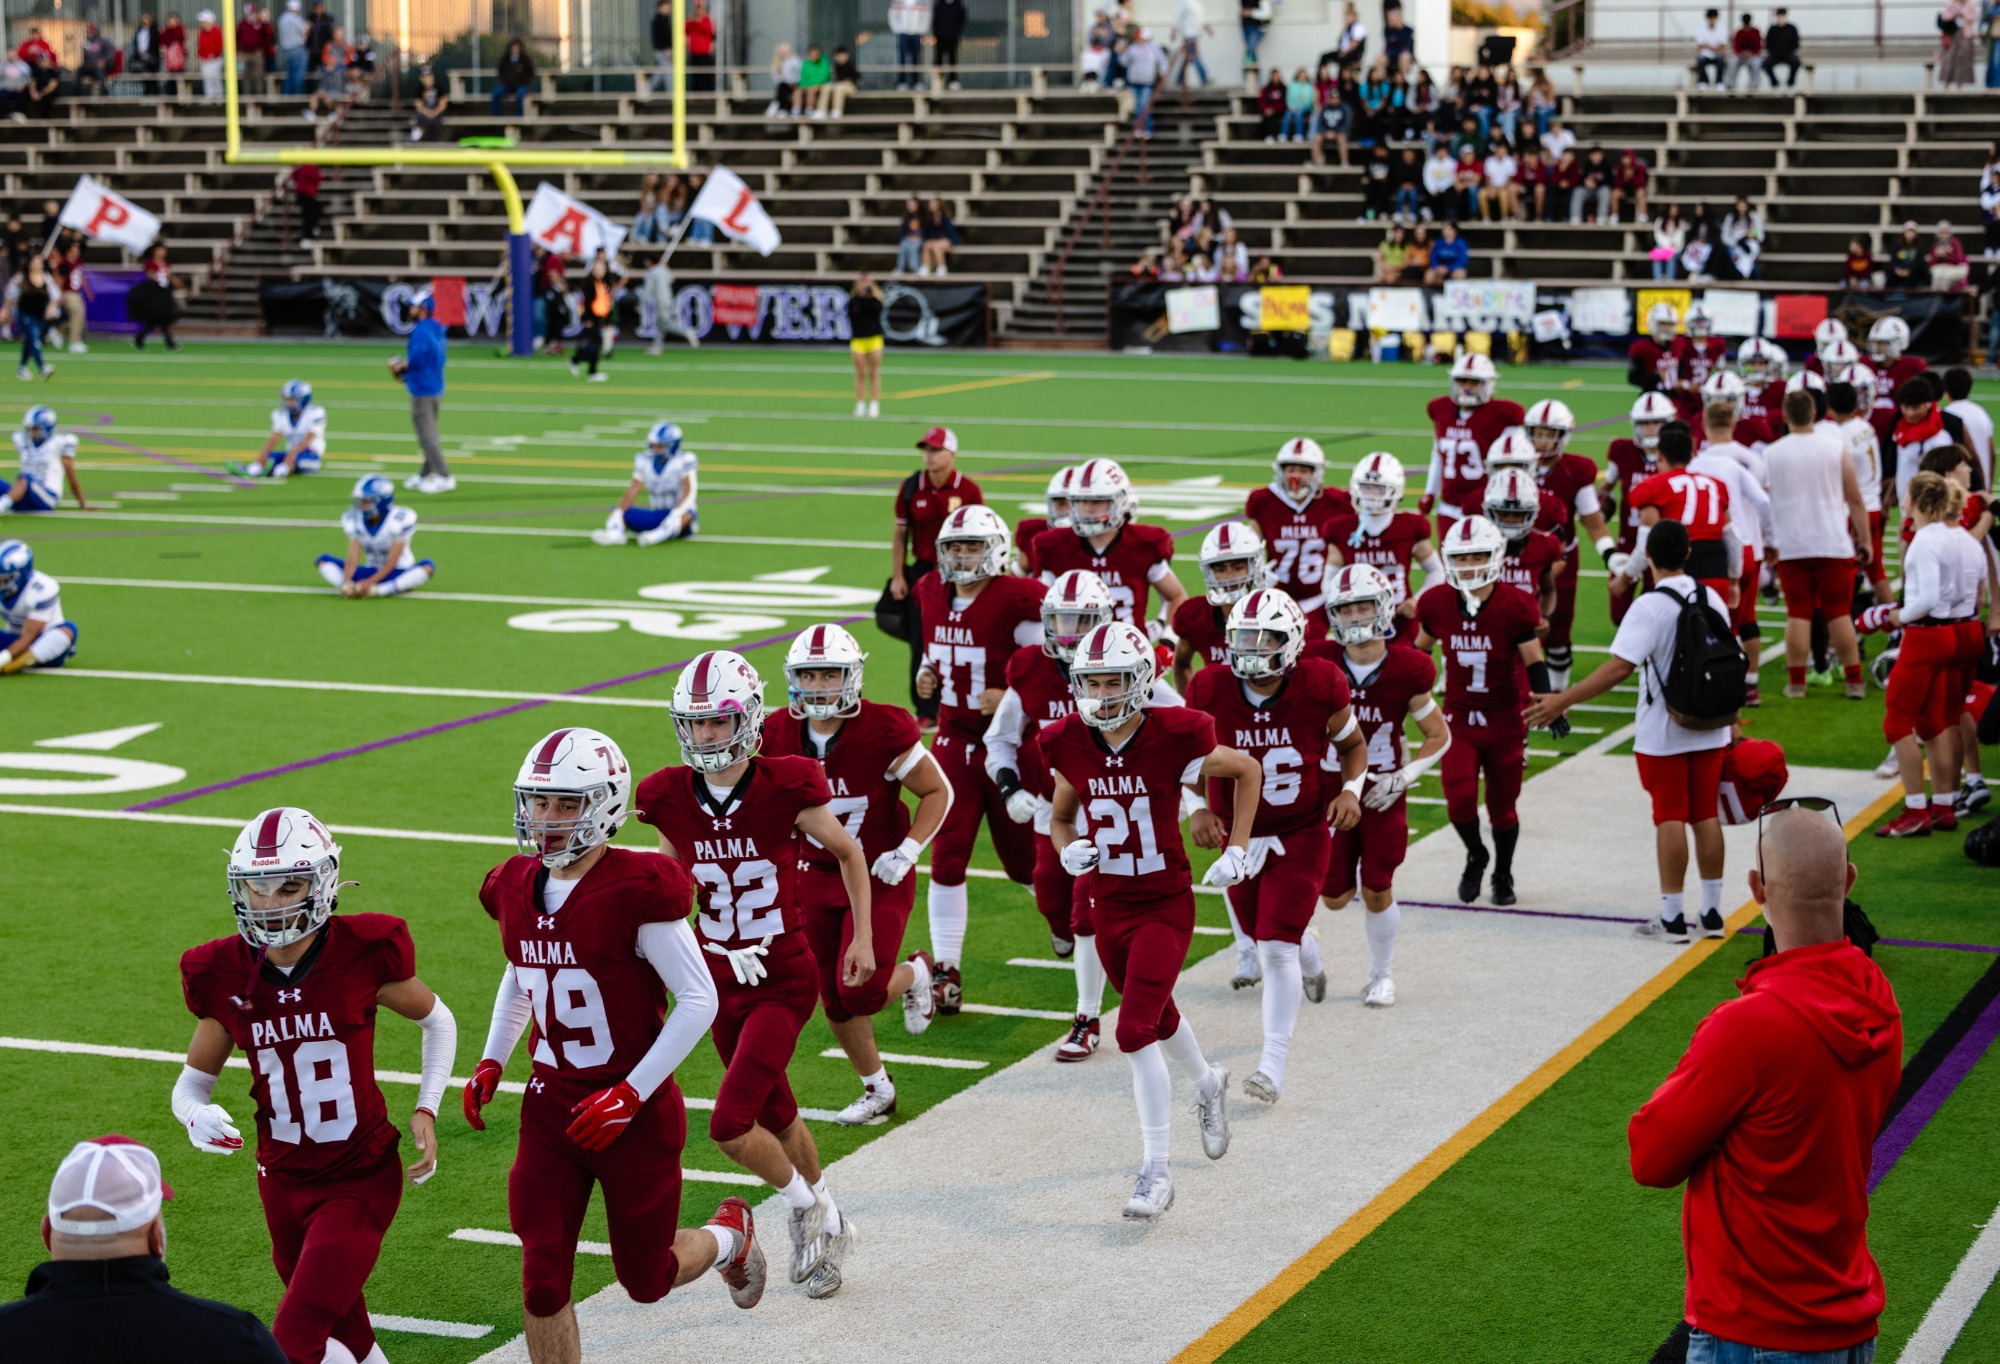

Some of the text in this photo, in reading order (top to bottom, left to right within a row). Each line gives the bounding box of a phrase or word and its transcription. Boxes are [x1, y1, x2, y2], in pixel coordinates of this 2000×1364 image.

[86, 194, 131, 236] P
[541, 206, 589, 257] A
[721, 187, 755, 234] L
[1440, 438, 1484, 480] 73
[1668, 474, 1720, 525] 77
[1281, 525, 1319, 540] PALMA
[1274, 539, 1326, 584] 76
[1354, 550, 1397, 566] PALMA
[935, 625, 974, 646] PALMA
[1451, 635, 1492, 650] PALMA
[927, 643, 987, 710] 77
[1457, 651, 1489, 693] 7
[689, 703, 713, 711] Riddell
[1235, 727, 1293, 747] PALMA
[1088, 776, 1148, 796] PALMA
[694, 837, 760, 860] PALMA
[1088, 796, 1167, 876] 21
[251, 858, 281, 867] Riddell
[691, 859, 786, 941] 32
[520, 940, 577, 966] PALMA
[251, 1012, 336, 1047] PALMA
[515, 967, 616, 1070] 79
[257, 1040, 358, 1146] 18
